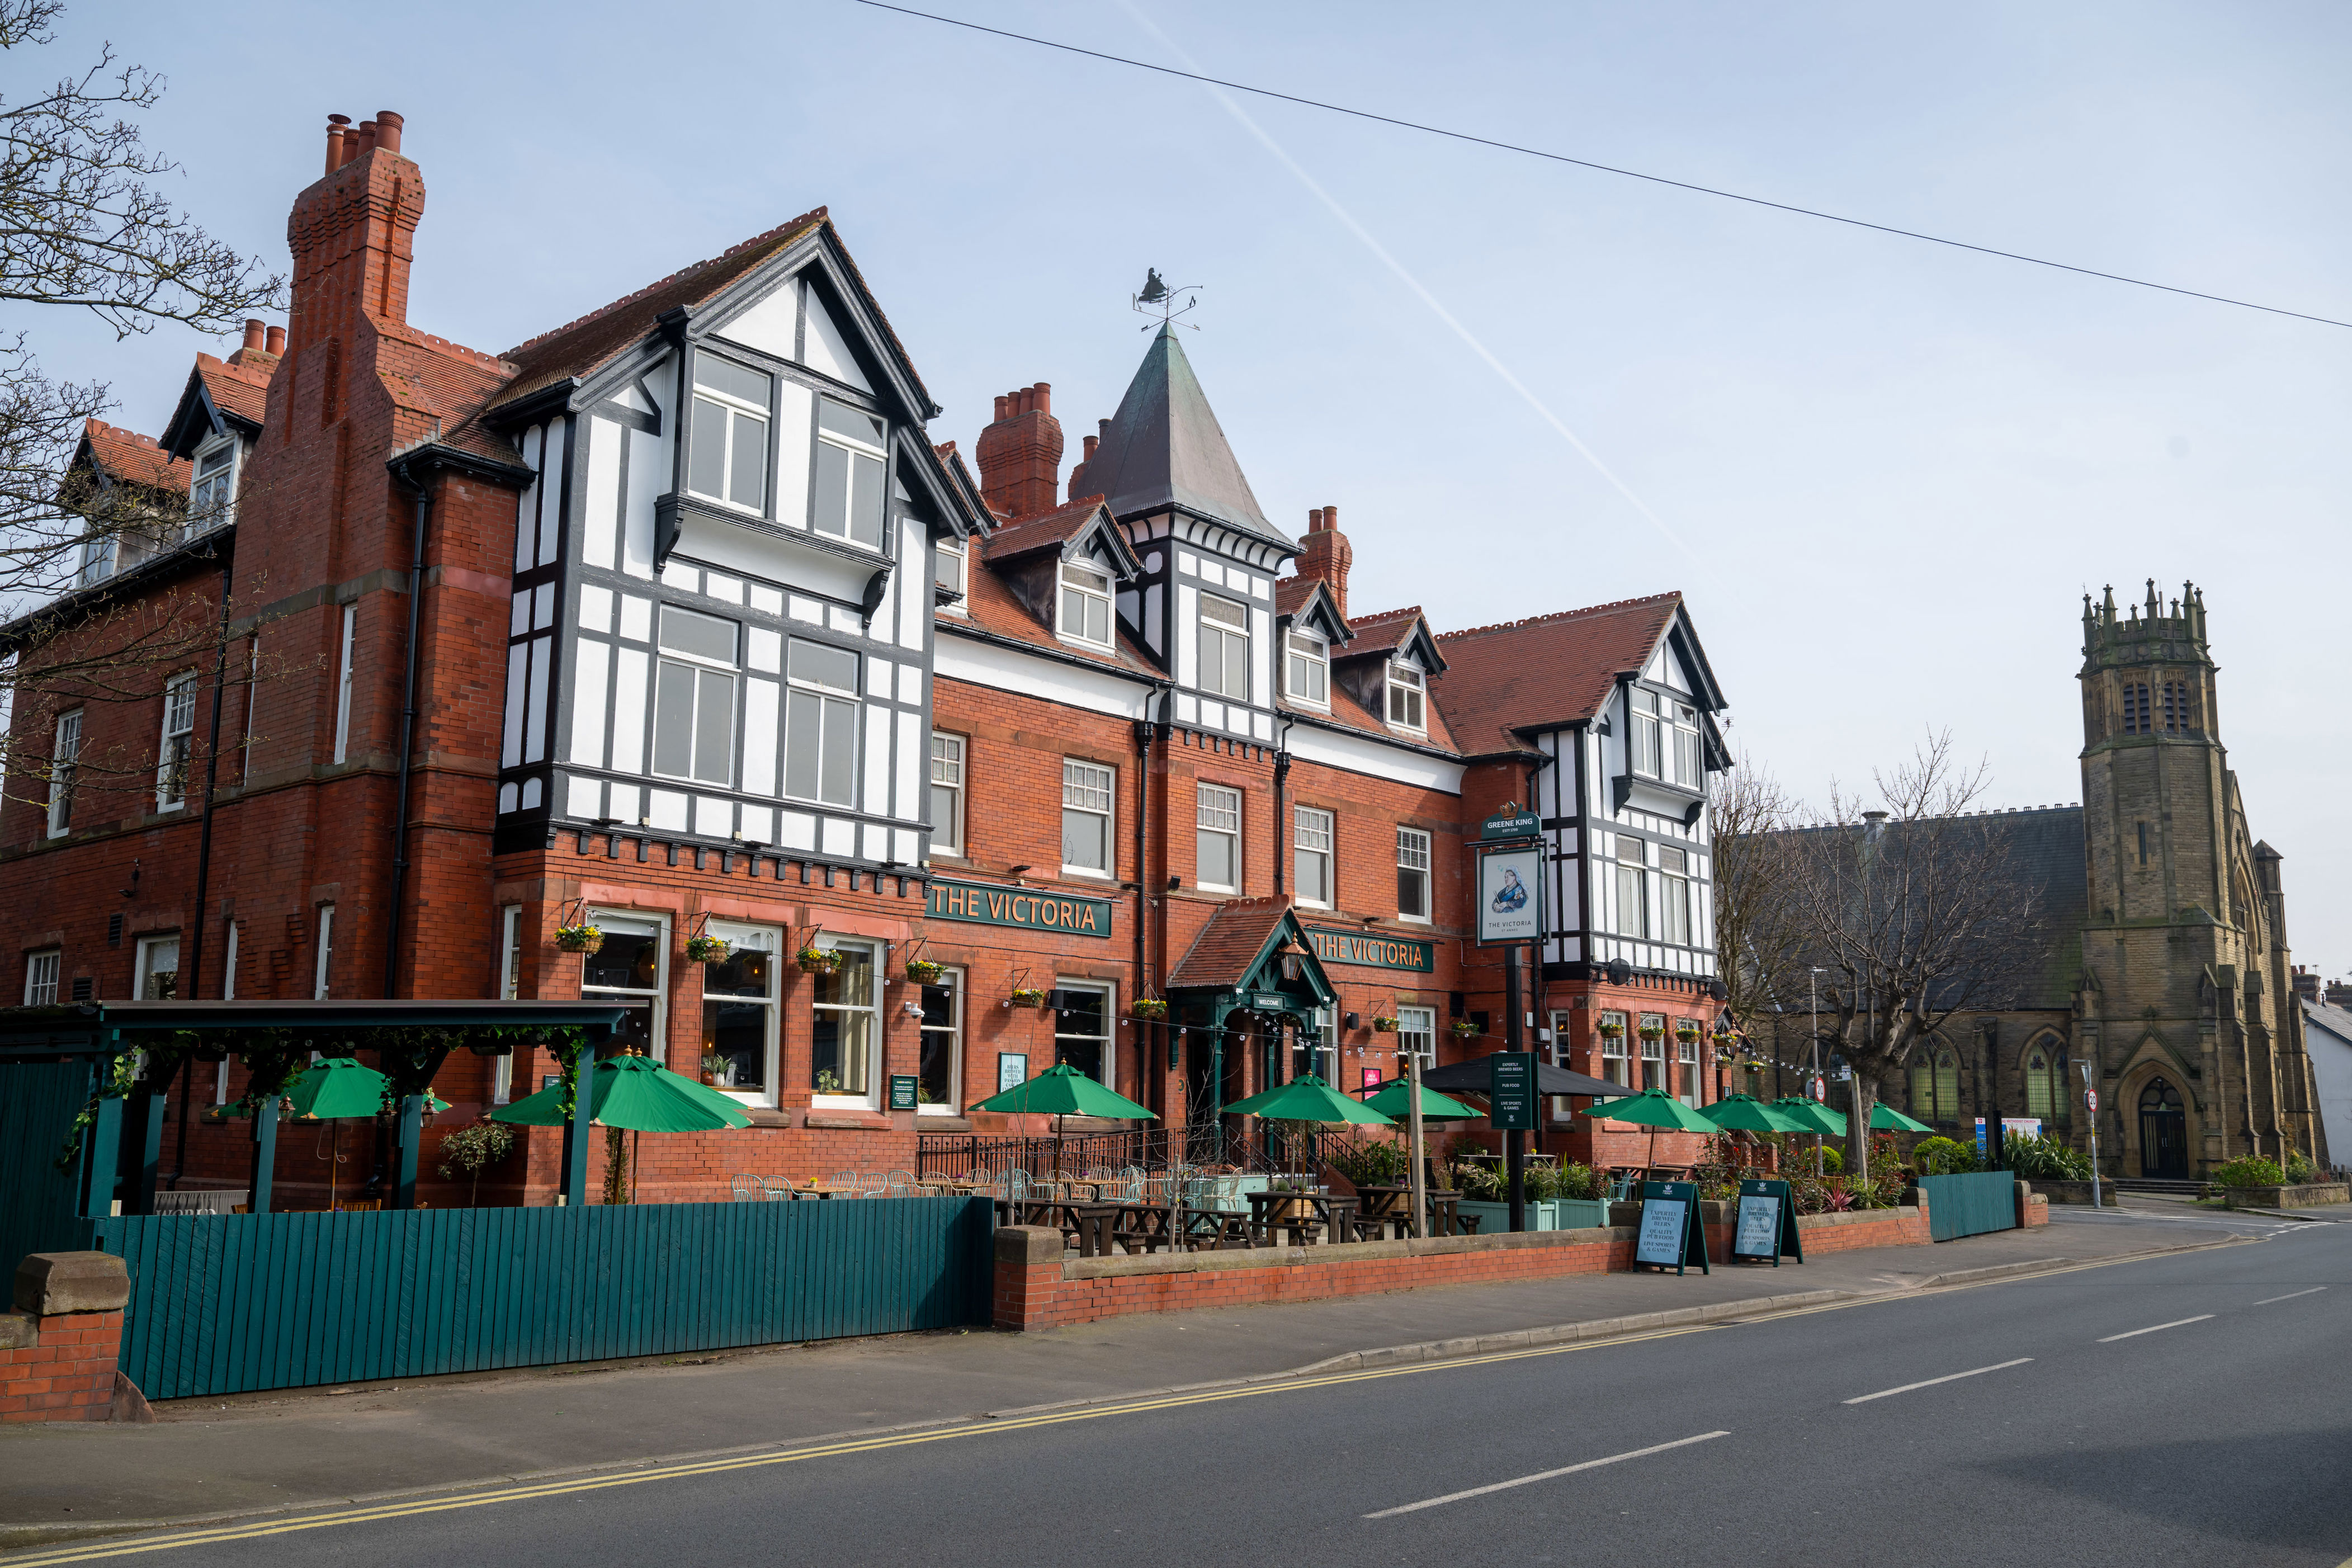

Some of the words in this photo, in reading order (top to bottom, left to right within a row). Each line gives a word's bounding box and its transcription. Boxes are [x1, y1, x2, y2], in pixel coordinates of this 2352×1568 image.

[1487, 820, 1514, 829] GREENE
[931, 885, 979, 917] THE
[987, 891, 1096, 931] VICTORIA
[1314, 934, 1346, 958] THE
[1350, 938, 1423, 967] VICTORIA
[1817, 1085, 1824, 1095] 20
[2089, 1096, 2096, 1105] 20
